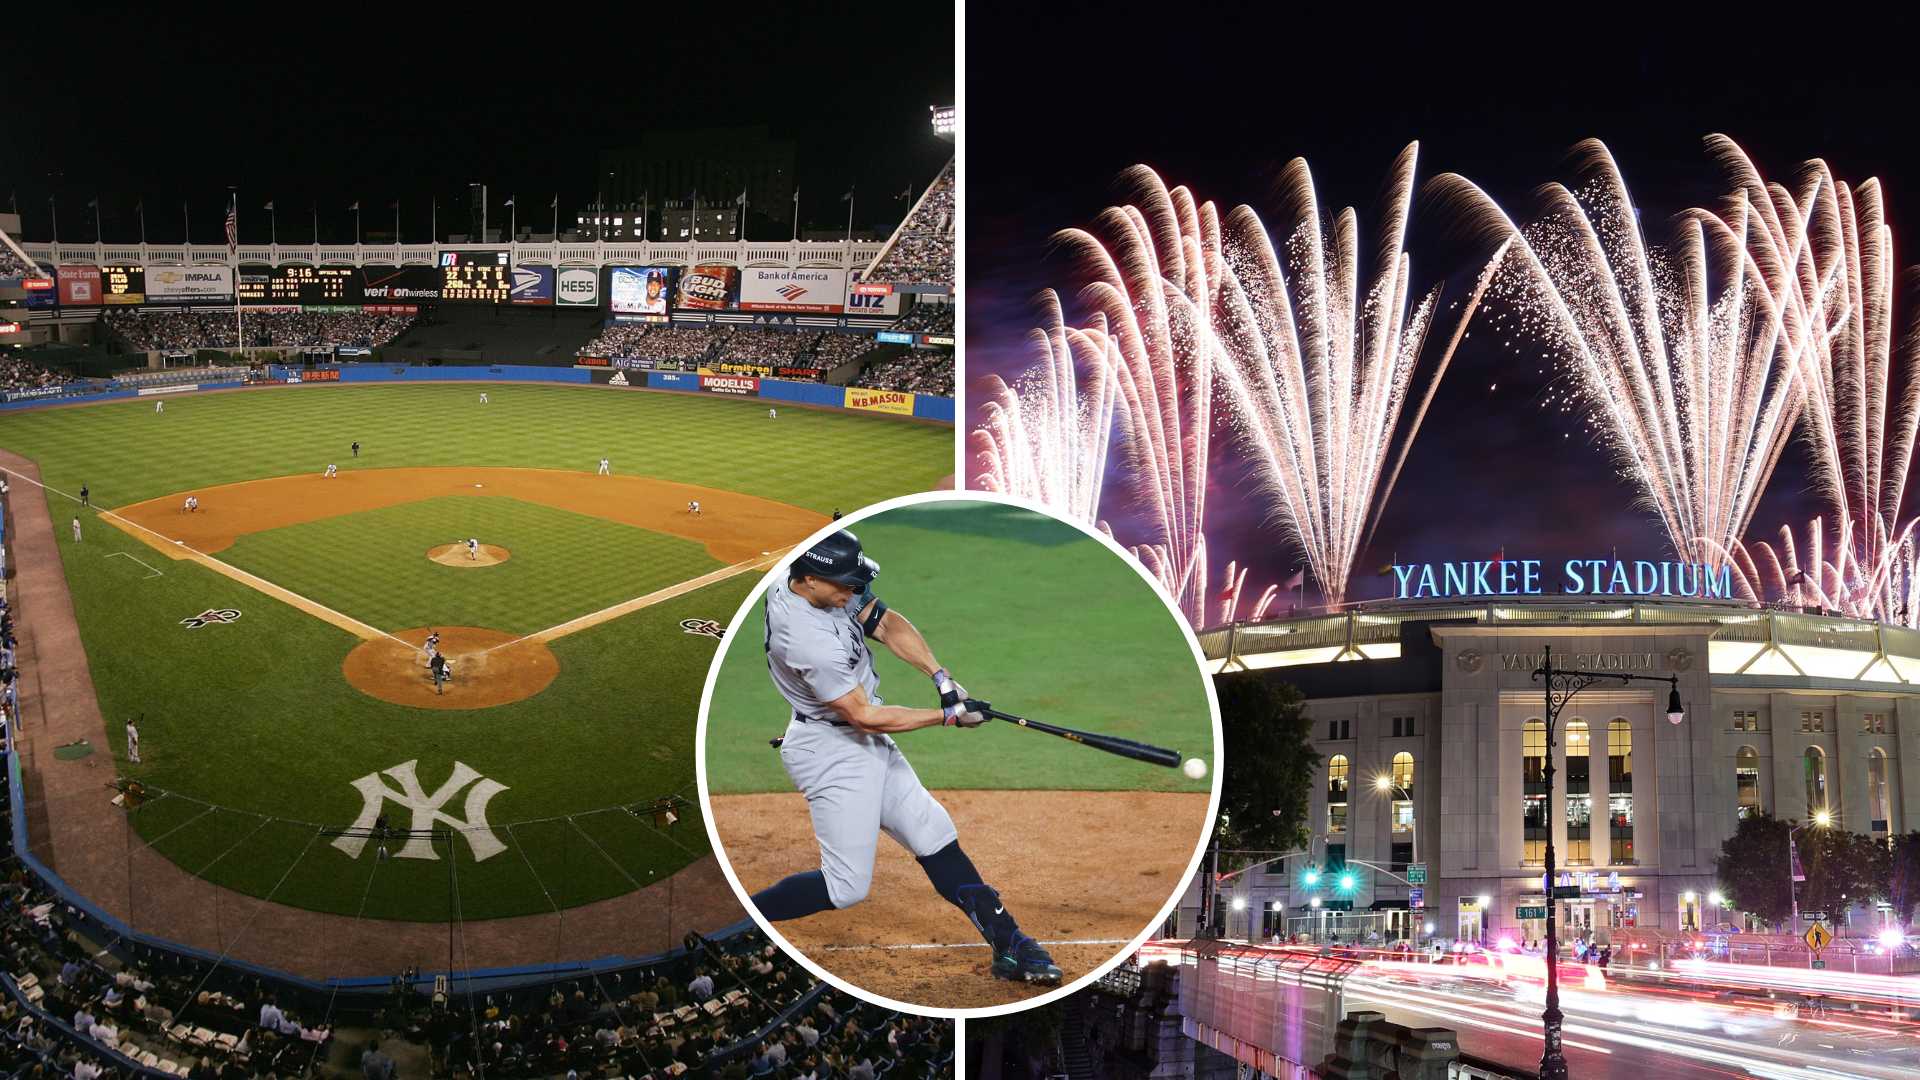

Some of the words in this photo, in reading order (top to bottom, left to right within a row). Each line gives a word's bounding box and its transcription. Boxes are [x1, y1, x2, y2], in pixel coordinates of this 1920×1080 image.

[60, 270, 76, 279] State
[78, 270, 100, 279] Farm
[184, 273, 222, 281] IMPALA
[287, 268, 312, 277] 9:16
[758, 271, 781, 281] Bank
[782, 272, 790, 281] of
[791, 272, 828, 282] America
[561, 280, 594, 292] HESS
[690, 275, 725, 289] BUD
[683, 283, 728, 299] LIGHT
[850, 293, 885, 308] UTZ
[578, 357, 607, 366] Canon
[615, 359, 630, 368] AIG
[721, 363, 769, 374] Armitron
[779, 367, 820, 376] SHARP
[704, 377, 754, 390] MODELL'S
[805, 551, 833, 565] STRAUSS
[1392, 560, 1542, 599] YANKEE
[1564, 559, 1732, 599] STADIUM
[1576, 653, 1655, 671] STADIUM
[330, 759, 511, 862] NY
[1608, 871, 1620, 892] 4
[1525, 907, 1537, 918] 161
